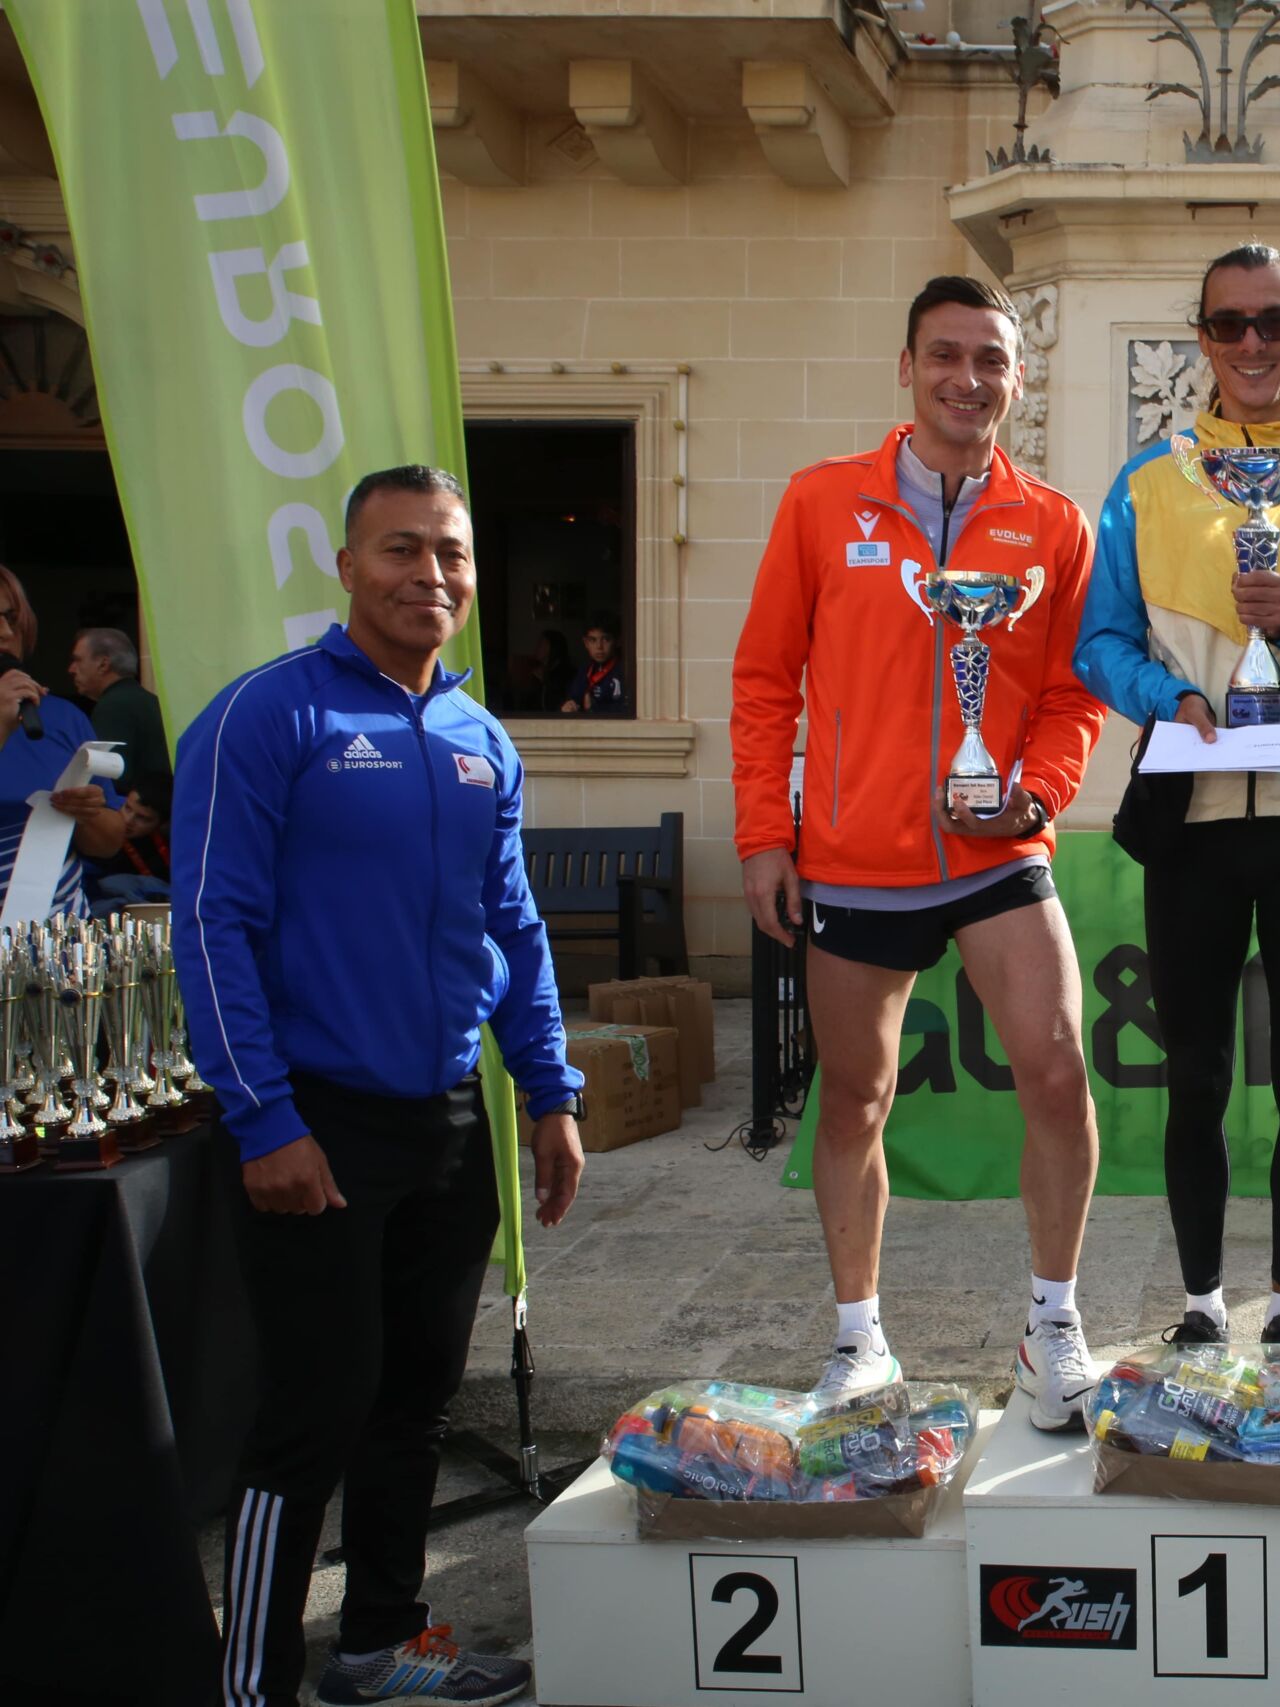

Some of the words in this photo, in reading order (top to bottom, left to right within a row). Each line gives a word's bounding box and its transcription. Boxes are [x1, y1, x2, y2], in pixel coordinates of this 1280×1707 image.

[989, 529, 1033, 544] EVOLVE
[848, 557, 888, 565] TEAMSPORT
[344, 748, 382, 759] adidas
[344, 761, 403, 769] EUROSPORT
[1178, 1553, 1228, 1659] 1
[711, 1571, 783, 1674] 2
